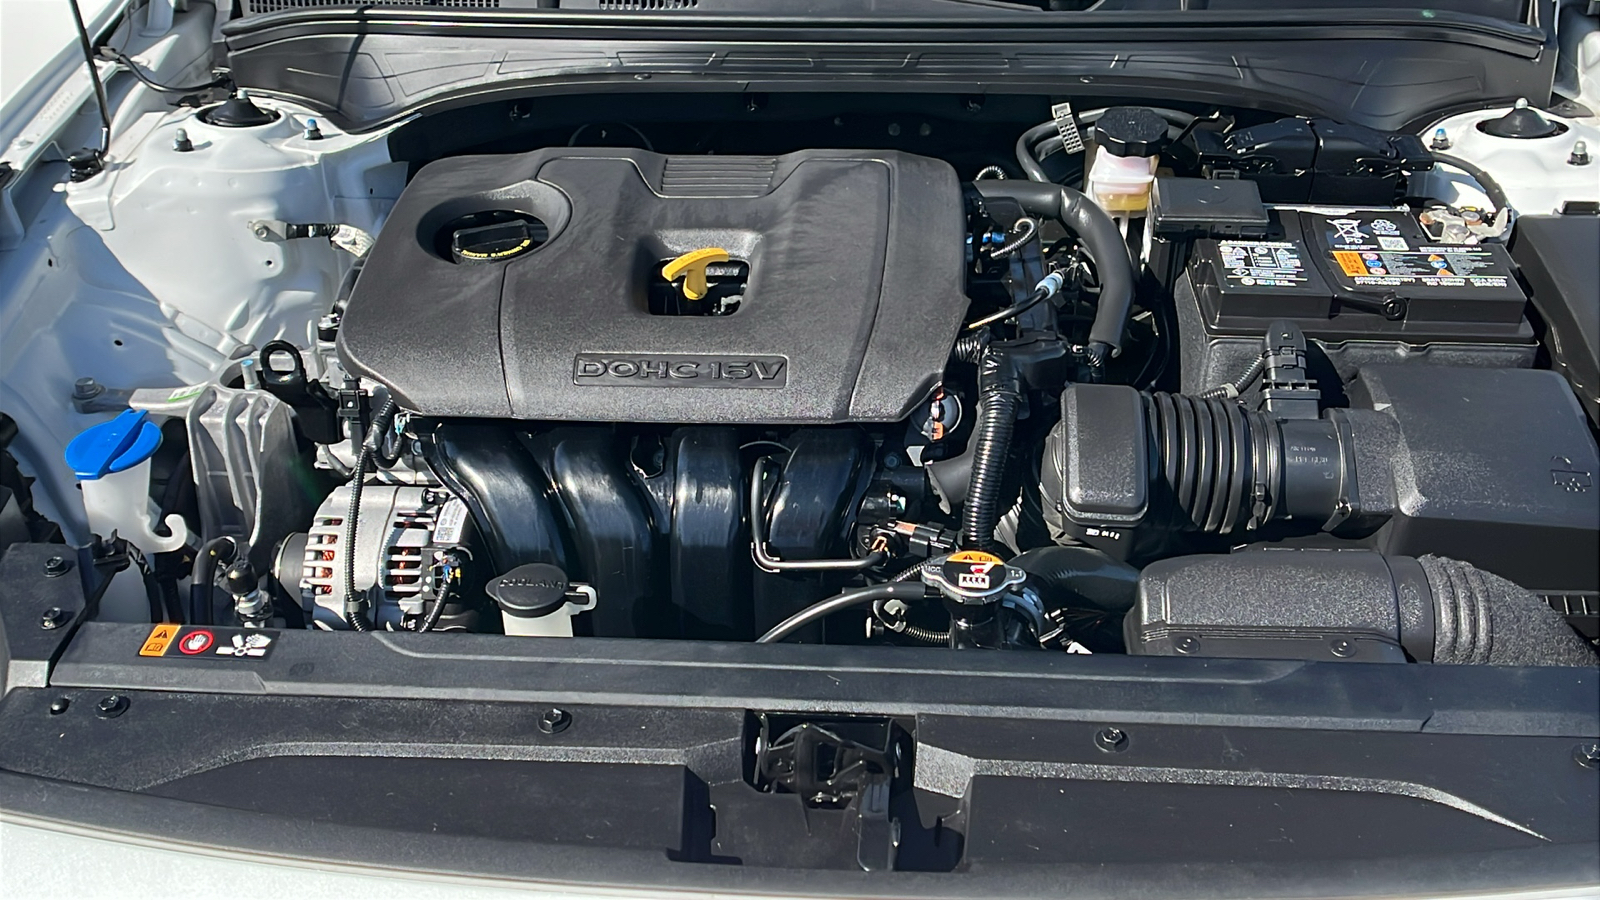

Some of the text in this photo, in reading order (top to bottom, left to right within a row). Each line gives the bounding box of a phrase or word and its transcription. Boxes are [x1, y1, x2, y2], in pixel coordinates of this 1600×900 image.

[577, 359, 785, 381] DOHC 16V
[498, 578, 566, 590] COOLANT
